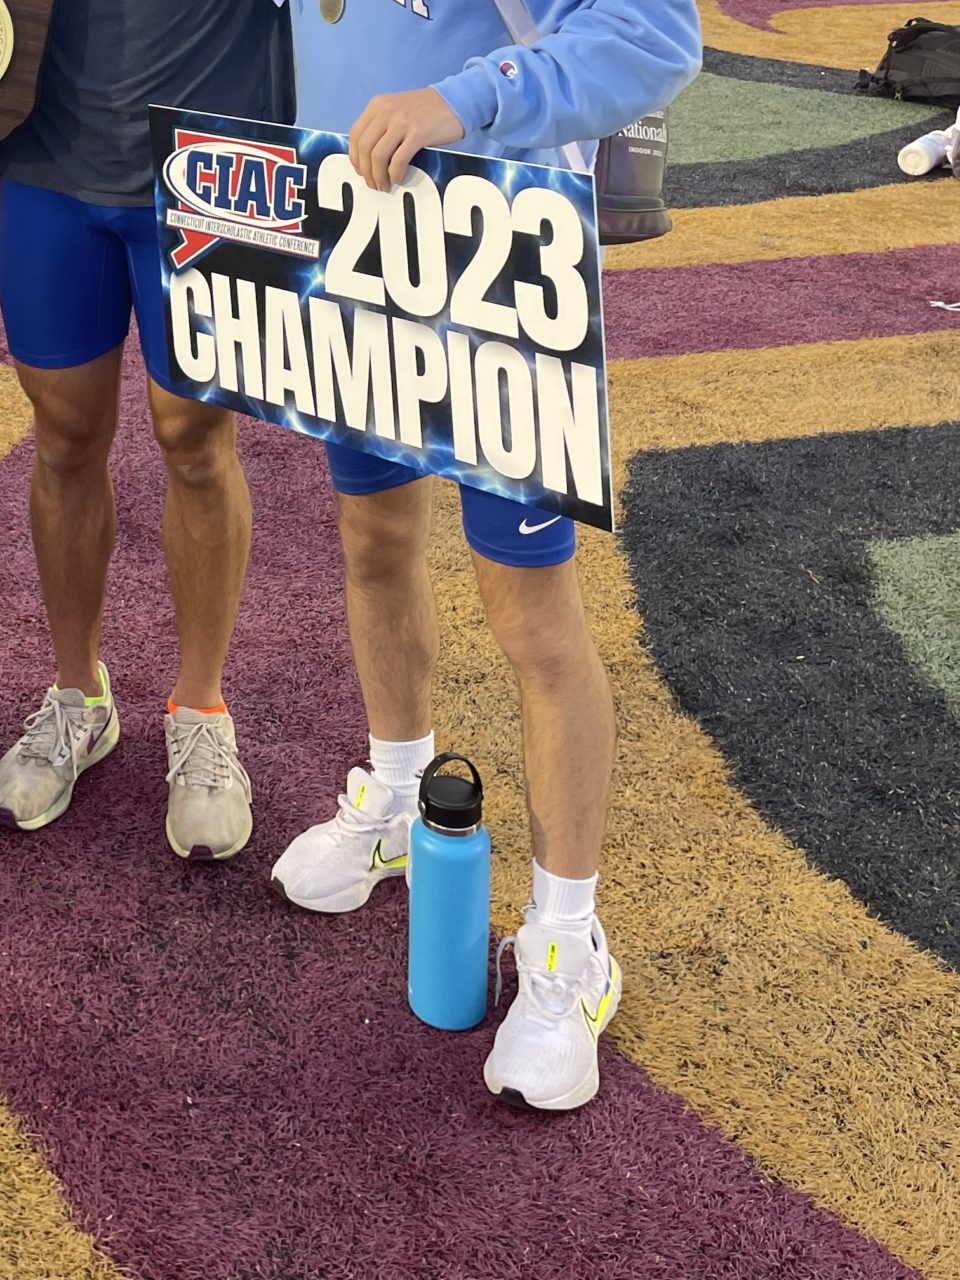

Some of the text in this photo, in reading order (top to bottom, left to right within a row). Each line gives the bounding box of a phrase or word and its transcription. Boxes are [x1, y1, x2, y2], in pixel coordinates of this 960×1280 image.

[170, 211, 316, 255] CONNECTICUT INTERSCHOLASTIC ATHLETIC CONFERENCE
[183, 149, 307, 222] CIAC
[317, 153, 589, 352] 2023
[169, 267, 604, 507] CHAMPION
